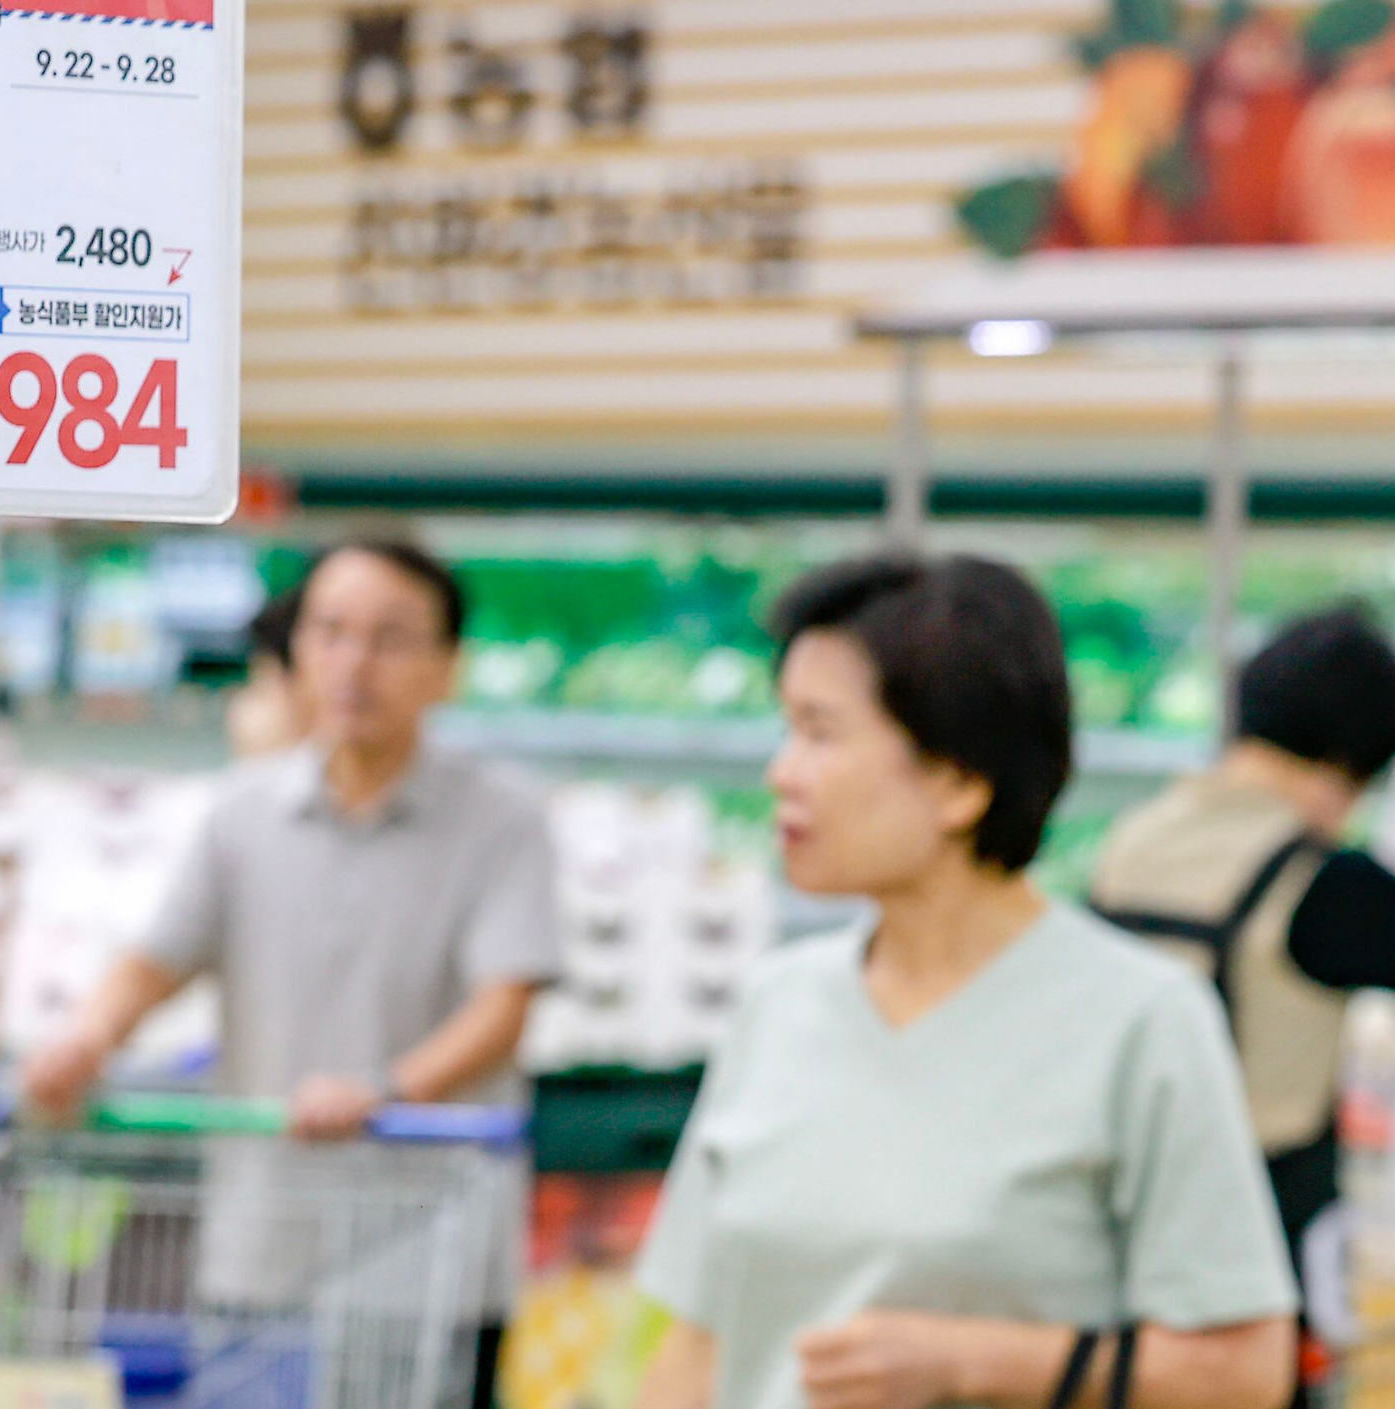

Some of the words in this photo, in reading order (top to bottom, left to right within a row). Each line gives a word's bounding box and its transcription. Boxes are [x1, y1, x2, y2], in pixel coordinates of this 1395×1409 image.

[56, 225, 152, 267] 2,480
[18, 299, 89, 328] 농식품부
[94, 303, 182, 331] 할인지원가
